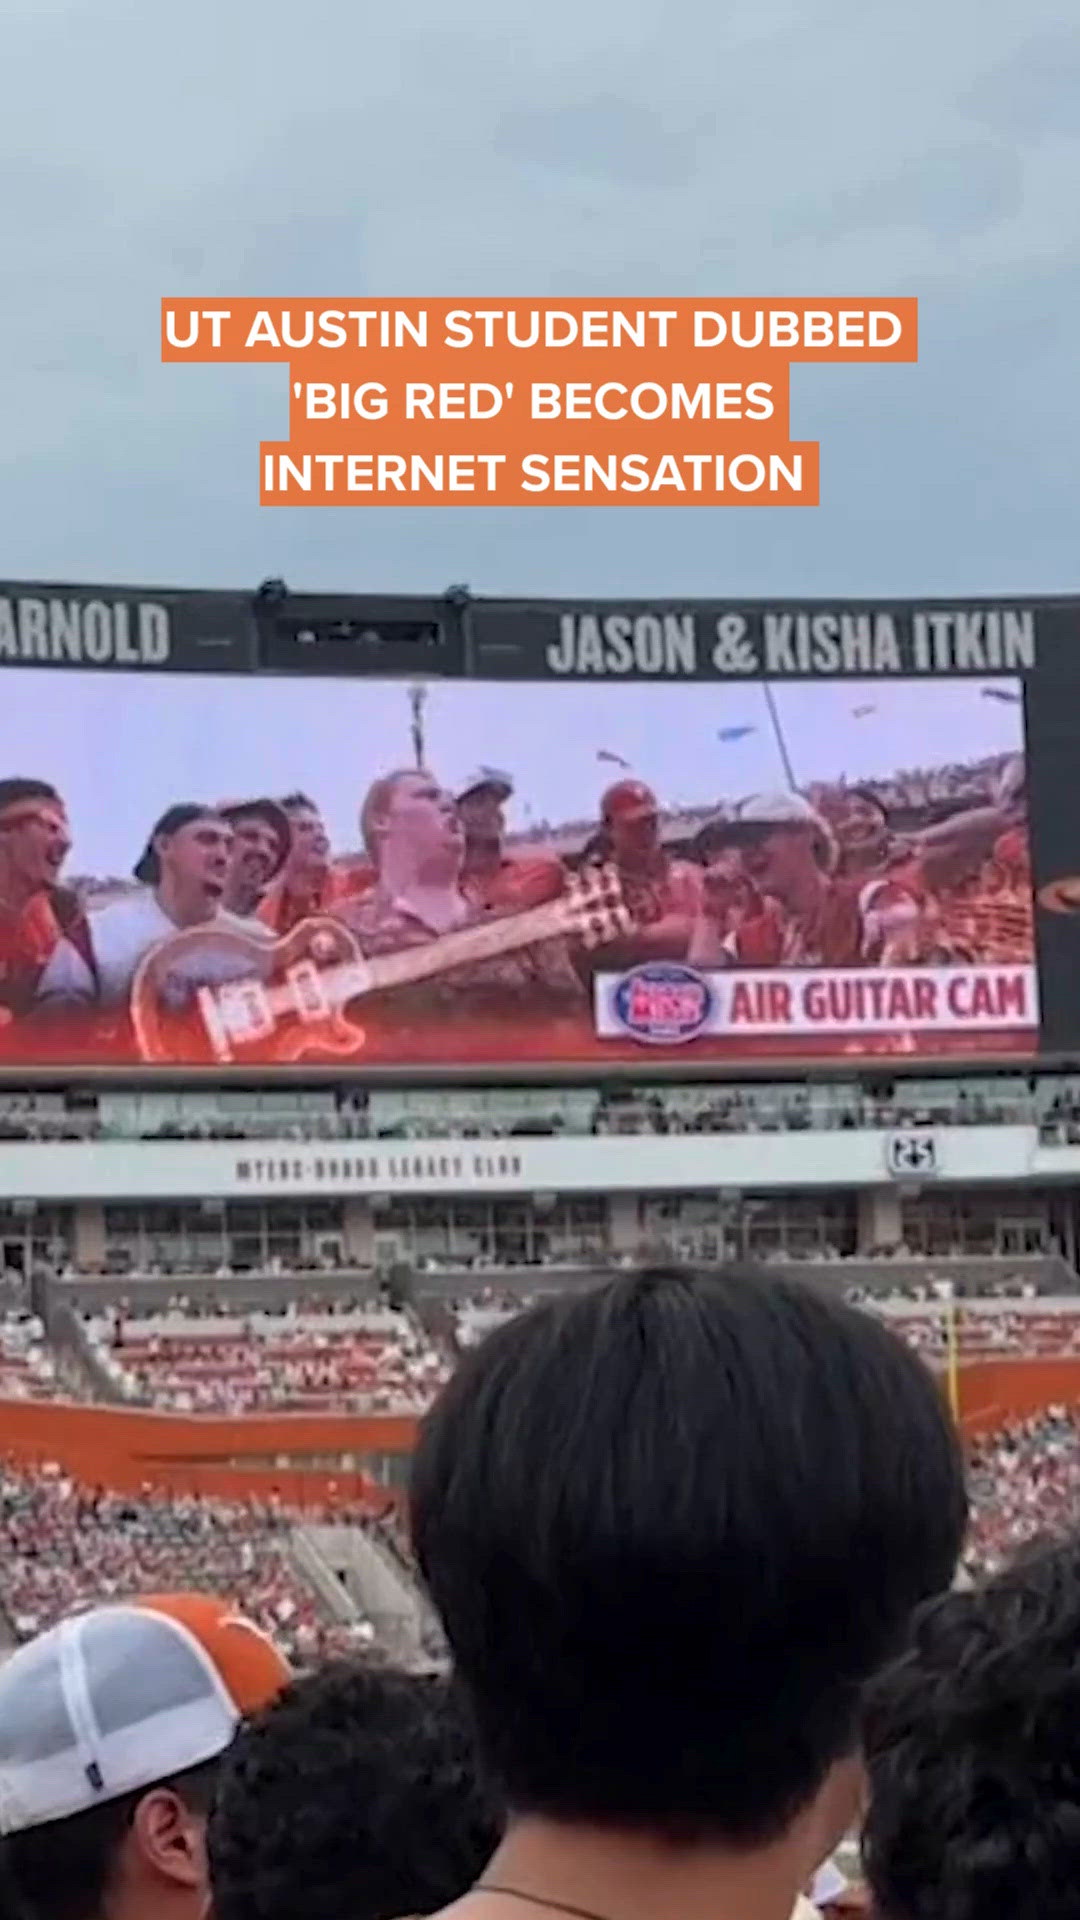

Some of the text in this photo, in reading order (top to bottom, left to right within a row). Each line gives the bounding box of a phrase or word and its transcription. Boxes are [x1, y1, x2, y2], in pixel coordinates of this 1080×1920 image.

[0, 598, 170, 664] ARNOLD
[547, 612, 1035, 674] JASON & KISHA ITKIN
[729, 979, 793, 1024] AIR
[803, 977, 938, 1022] GUITAR
[947, 974, 1026, 1018] CAM
